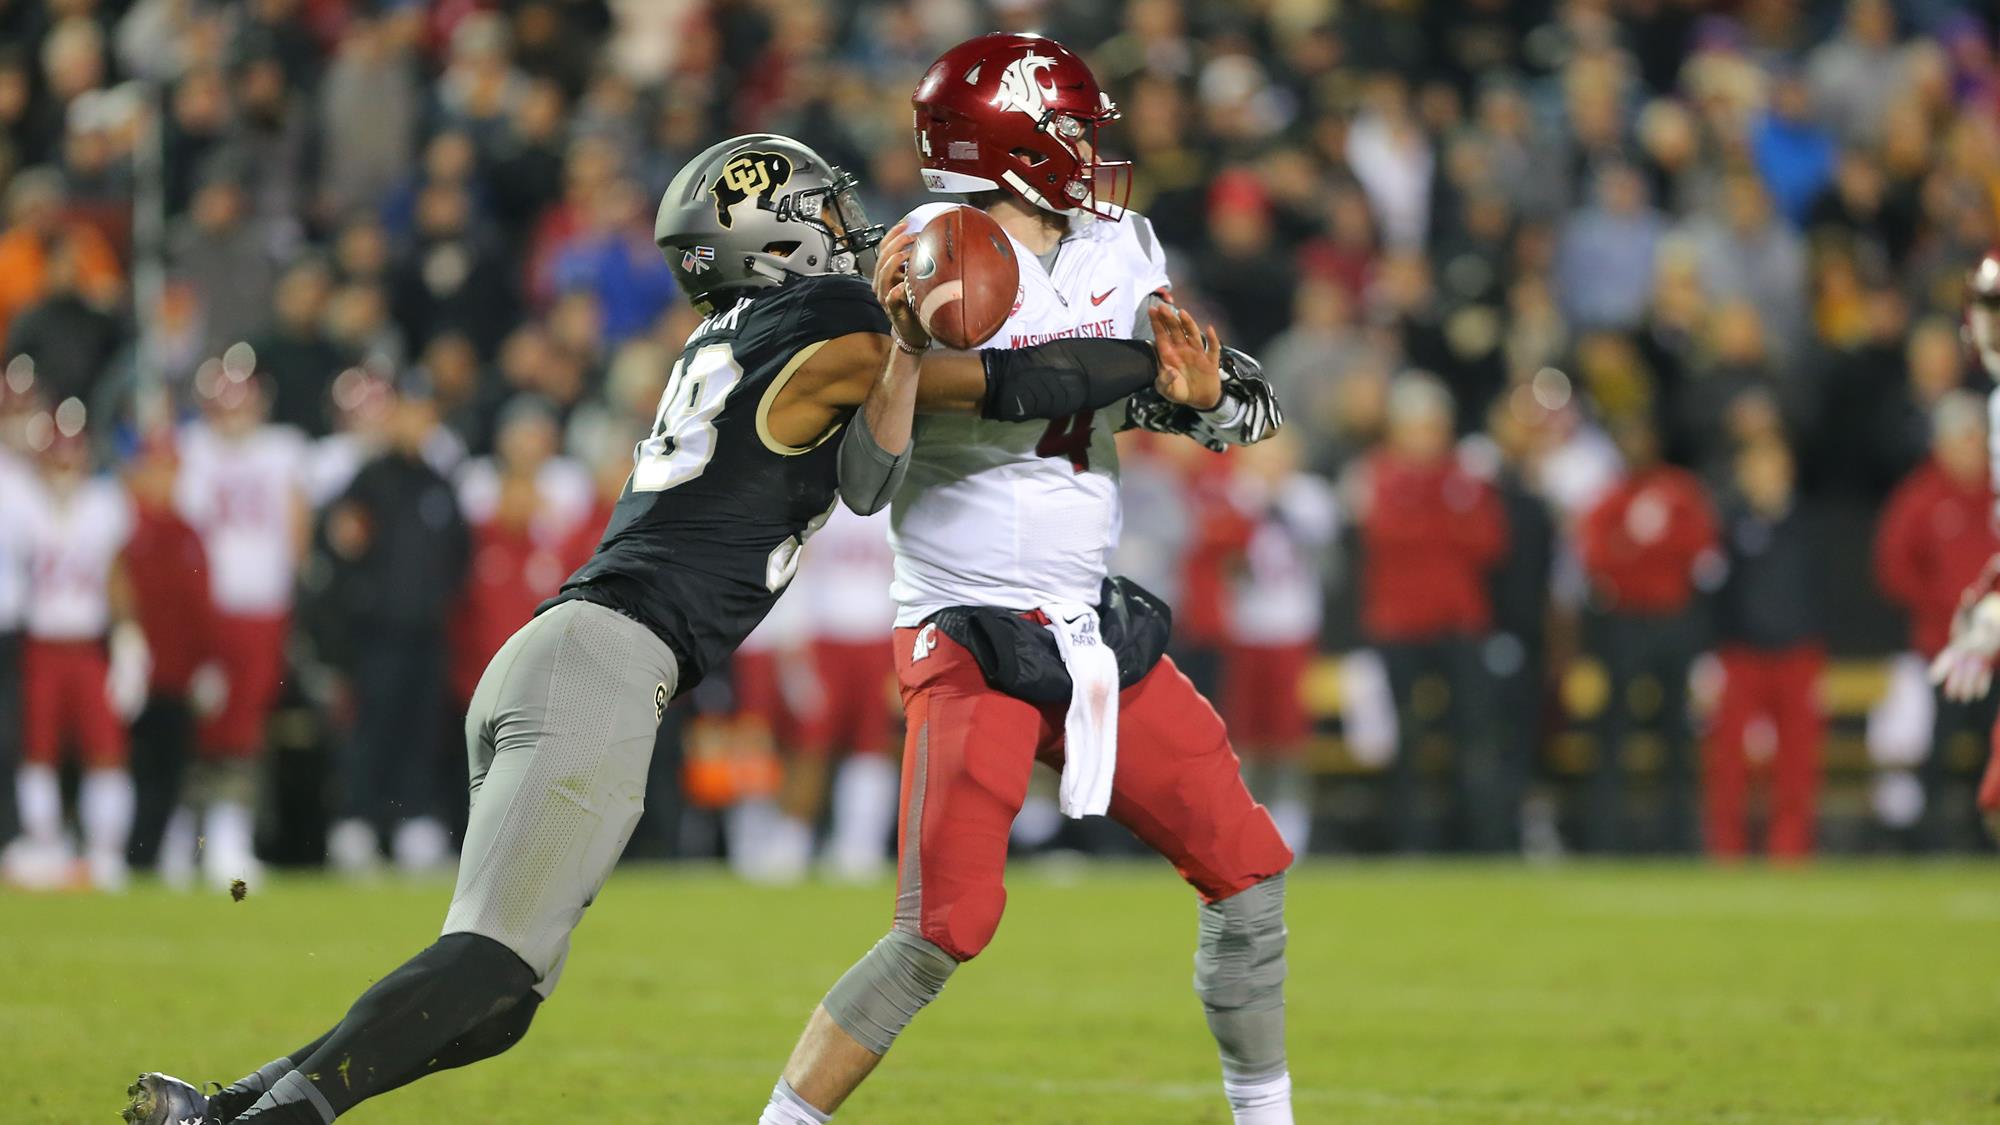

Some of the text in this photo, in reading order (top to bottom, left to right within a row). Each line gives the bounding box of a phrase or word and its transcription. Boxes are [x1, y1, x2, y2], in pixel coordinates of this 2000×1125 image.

[1010, 318, 1116, 350] WASHINT STATE
[1036, 408, 1097, 475] 4
